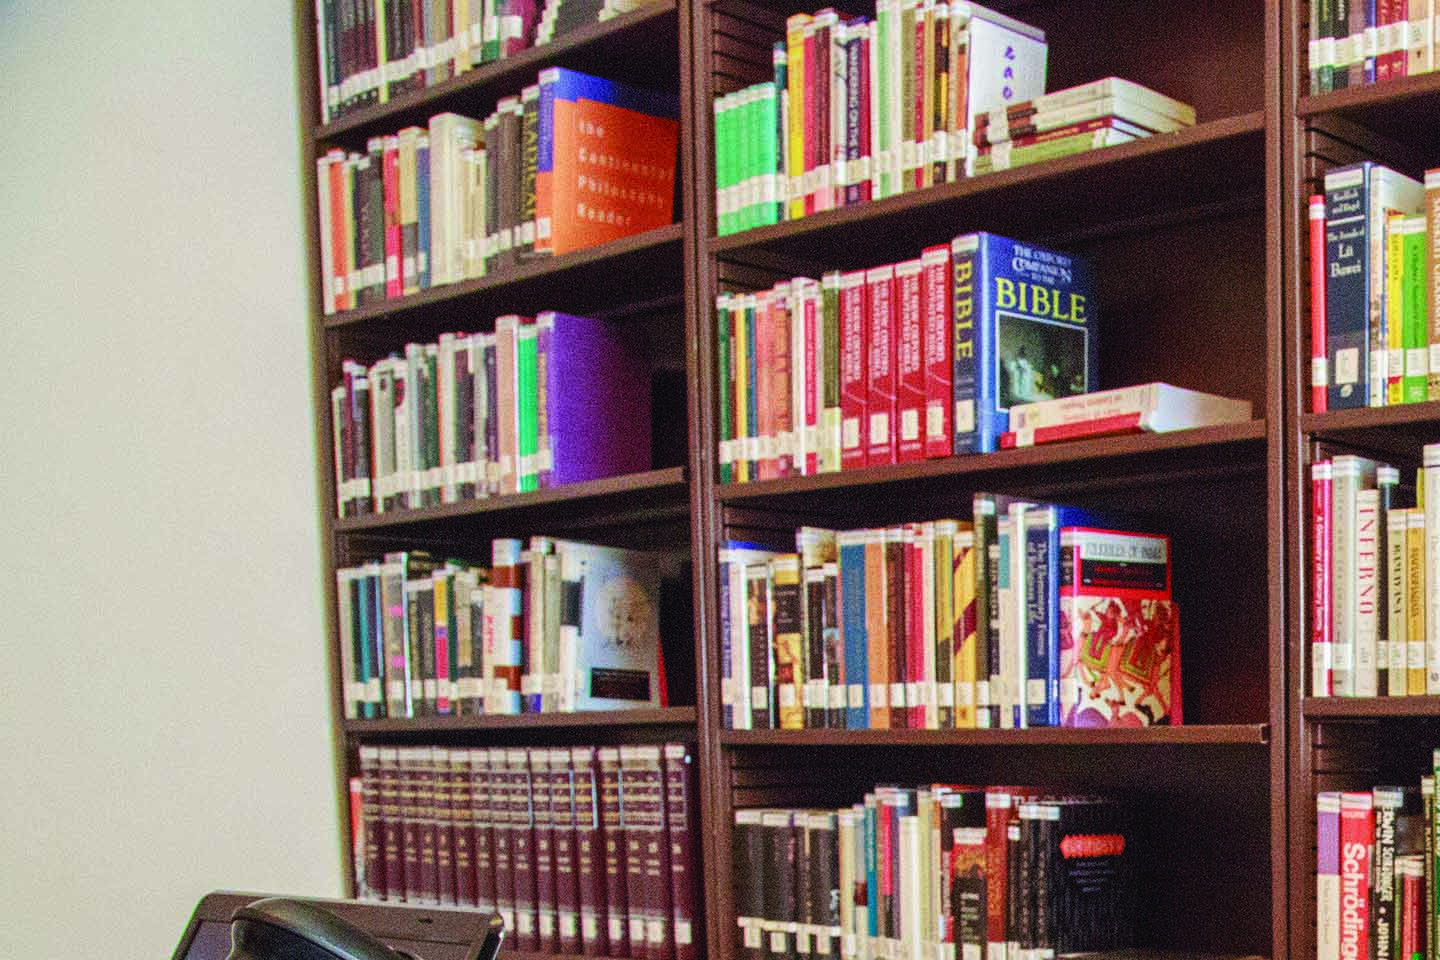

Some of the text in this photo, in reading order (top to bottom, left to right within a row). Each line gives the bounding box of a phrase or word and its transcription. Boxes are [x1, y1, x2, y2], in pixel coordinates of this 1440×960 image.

[955, 260, 973, 361] BIBLE
[995, 276, 1087, 322] BIBLE
[1358, 508, 1376, 615] INFERNO
[1377, 918, 1390, 956] JOHN
